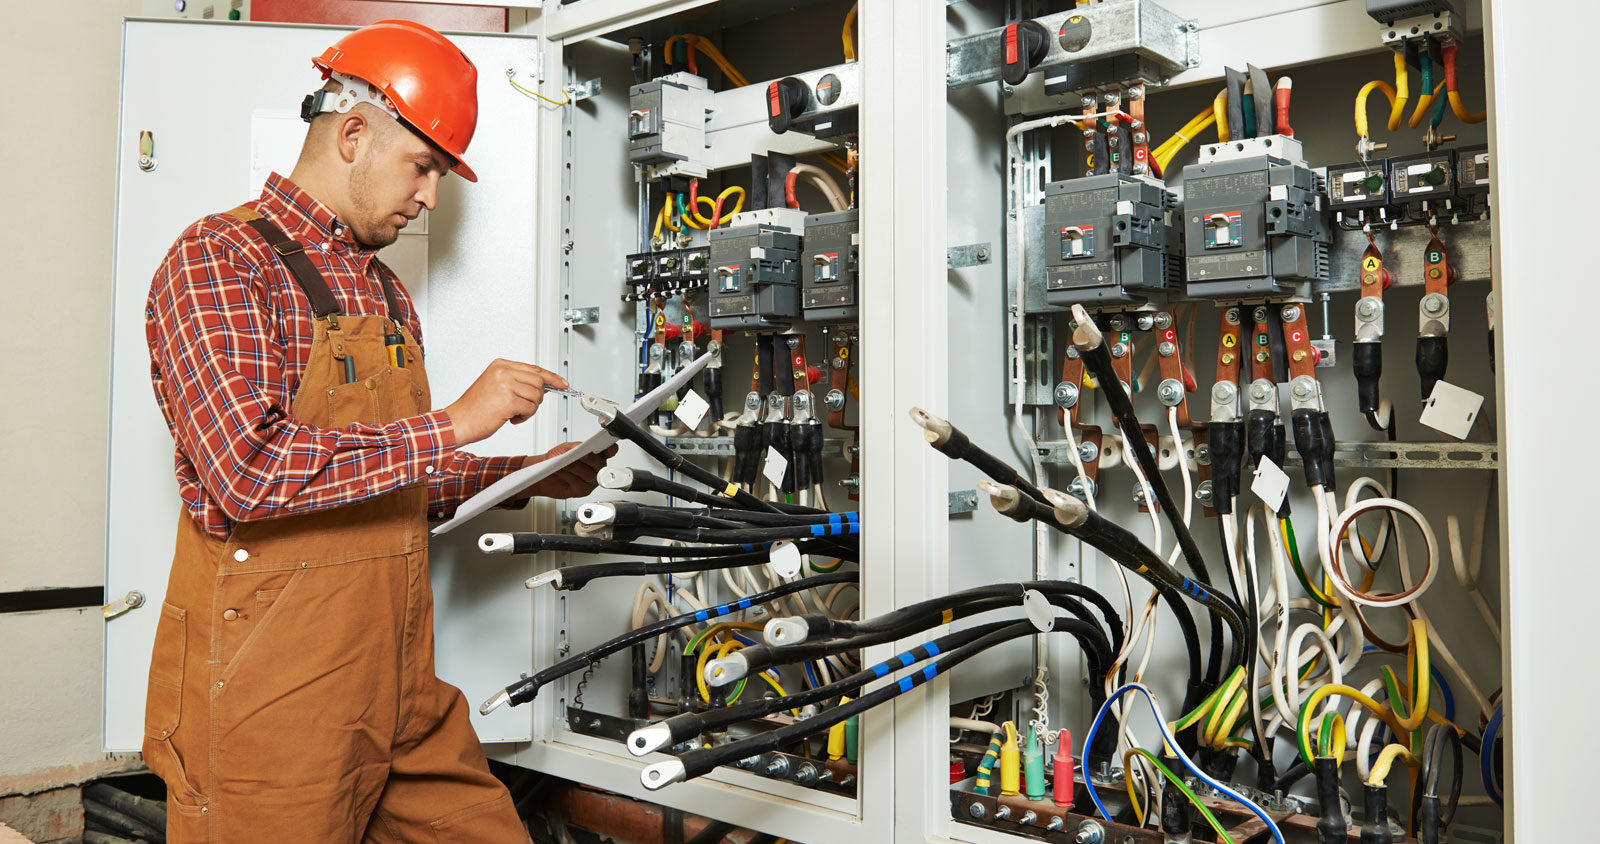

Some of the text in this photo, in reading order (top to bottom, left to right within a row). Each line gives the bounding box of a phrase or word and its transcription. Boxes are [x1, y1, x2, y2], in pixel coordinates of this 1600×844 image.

[1113, 152, 1120, 162] B
[1136, 149, 1144, 159] C
[1430, 252, 1440, 262] B
[1366, 259, 1376, 268] A
[684, 315, 689, 323] B
[1121, 332, 1129, 341] B
[1165, 330, 1173, 340] C
[1225, 335, 1234, 344] A
[1260, 335, 1268, 344] B
[1292, 332, 1301, 342] C
[841, 348, 847, 356] A
[795, 356, 801, 365] C
